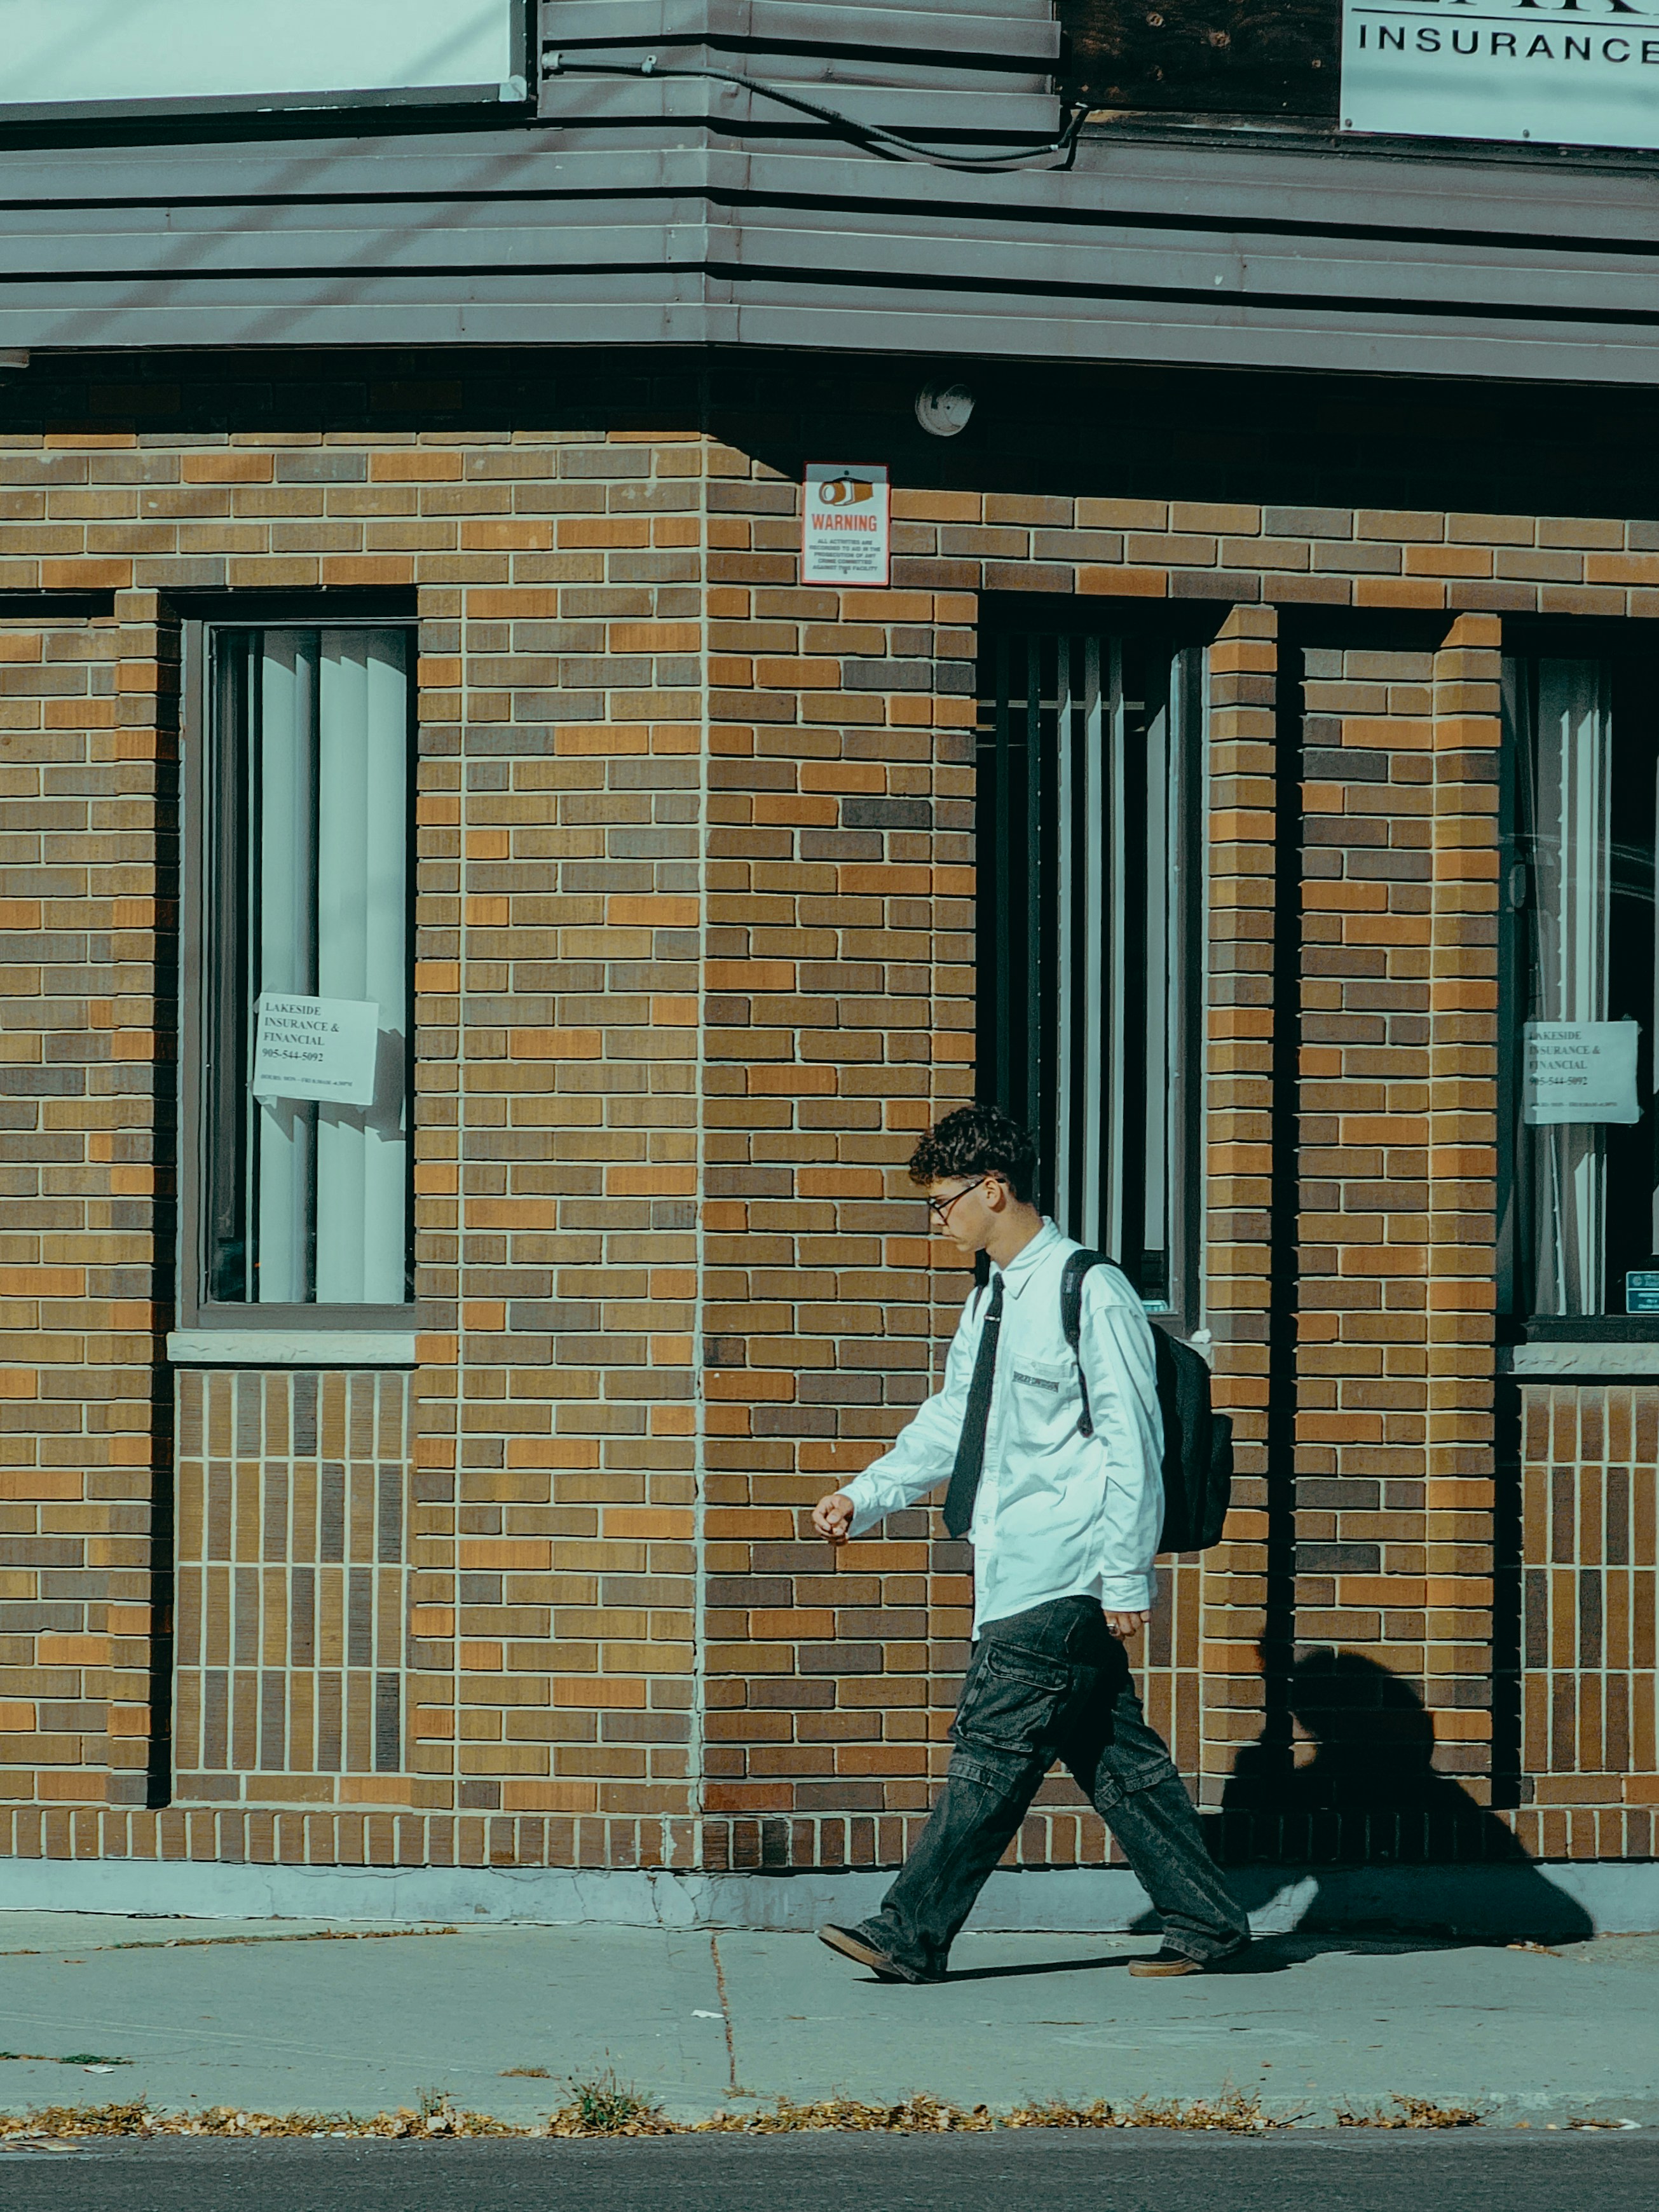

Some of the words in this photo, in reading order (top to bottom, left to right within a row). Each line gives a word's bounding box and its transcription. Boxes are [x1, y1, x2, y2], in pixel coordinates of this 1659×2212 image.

[1359, 24, 1659, 64] INSURANCE
[811, 513, 877, 531] WARNING
[265, 1002, 322, 1015] LAKESIDE
[264, 1017, 328, 1031] INSURANCE
[331, 1023, 339, 1032] &
[263, 1032, 325, 1046] FINANCIAL
[1529, 1031, 1582, 1040] LAKESIDE
[262, 1048, 324, 1062] 905-544-5092
[1592, 1045, 1601, 1054] &
[1529, 1061, 1588, 1069] FINANCIAL
